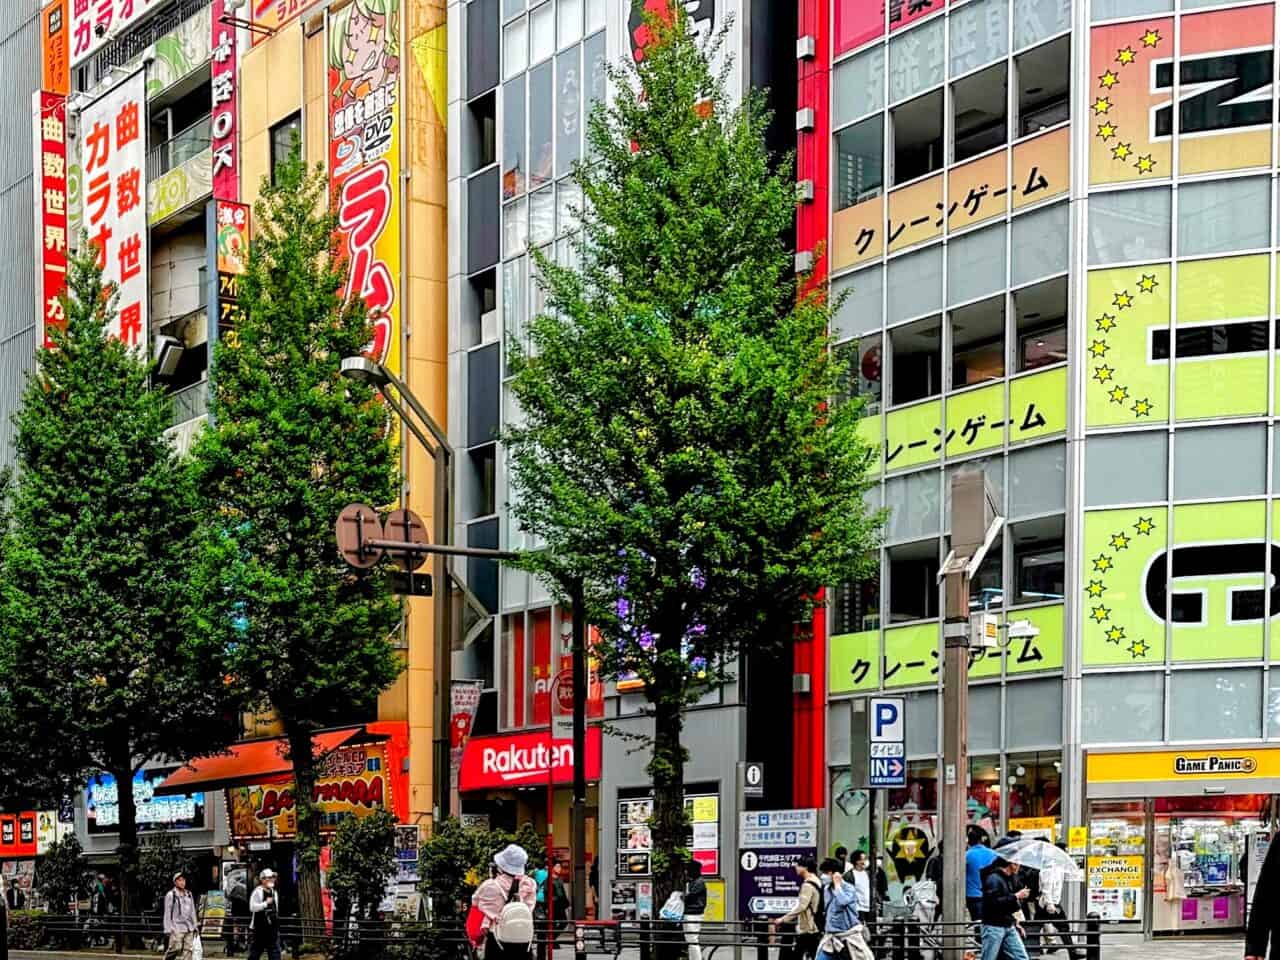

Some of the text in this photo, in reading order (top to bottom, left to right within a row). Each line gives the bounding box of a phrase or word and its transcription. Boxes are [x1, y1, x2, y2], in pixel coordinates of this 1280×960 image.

[365, 114, 393, 142] DVD
[854, 166, 1049, 257] クレーンゲーム
[851, 634, 1044, 685] クレーンーム
[876, 703, 898, 737] P
[482, 742, 574, 774] Rakuten
[870, 759, 888, 777] IN
[1176, 756, 1241, 772] GAME PANIC
[1089, 866, 1139, 874] EXCHANGE
